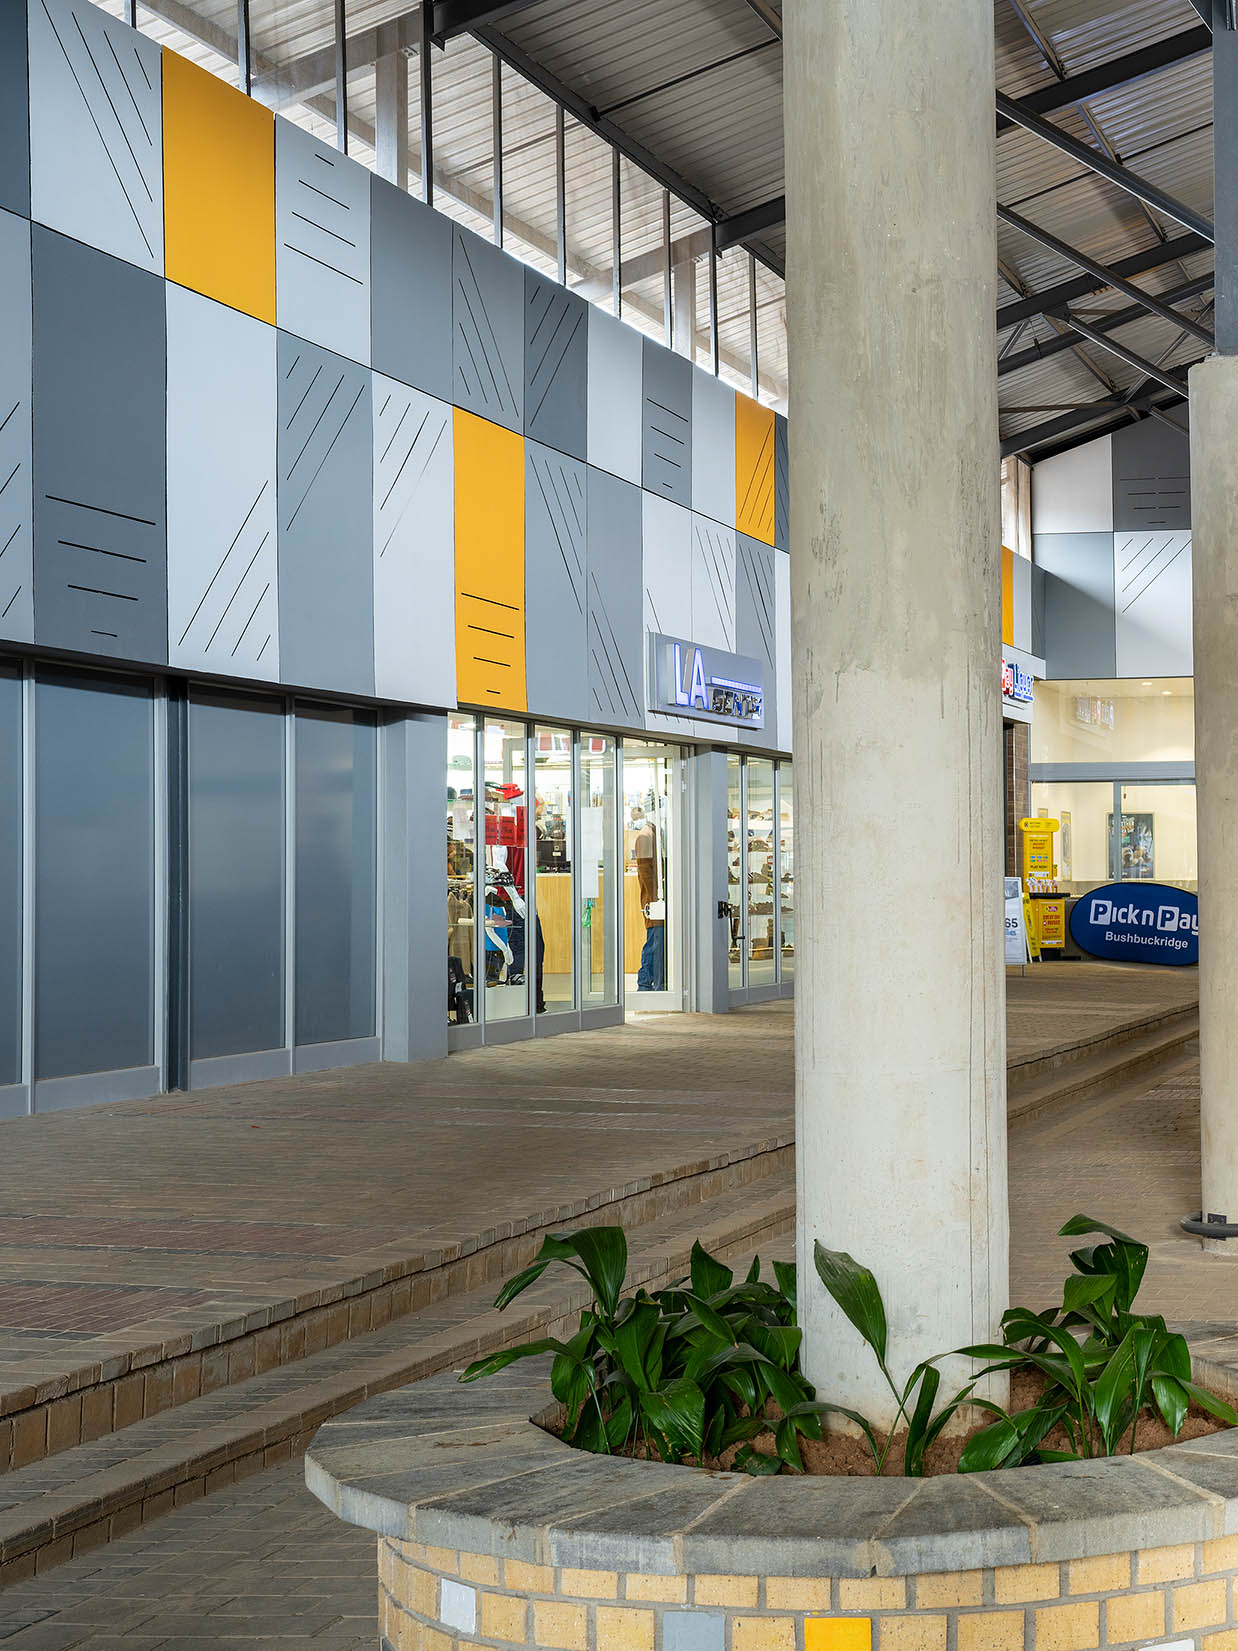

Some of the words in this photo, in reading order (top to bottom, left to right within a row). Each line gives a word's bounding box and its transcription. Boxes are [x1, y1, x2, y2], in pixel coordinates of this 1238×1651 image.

[674, 642, 709, 709] LA
[1089, 899, 1140, 925] Pick
[1141, 910, 1155, 926] n
[1156, 905, 1198, 936] Pay
[1105, 931, 1188, 950] Bushbuckridge
